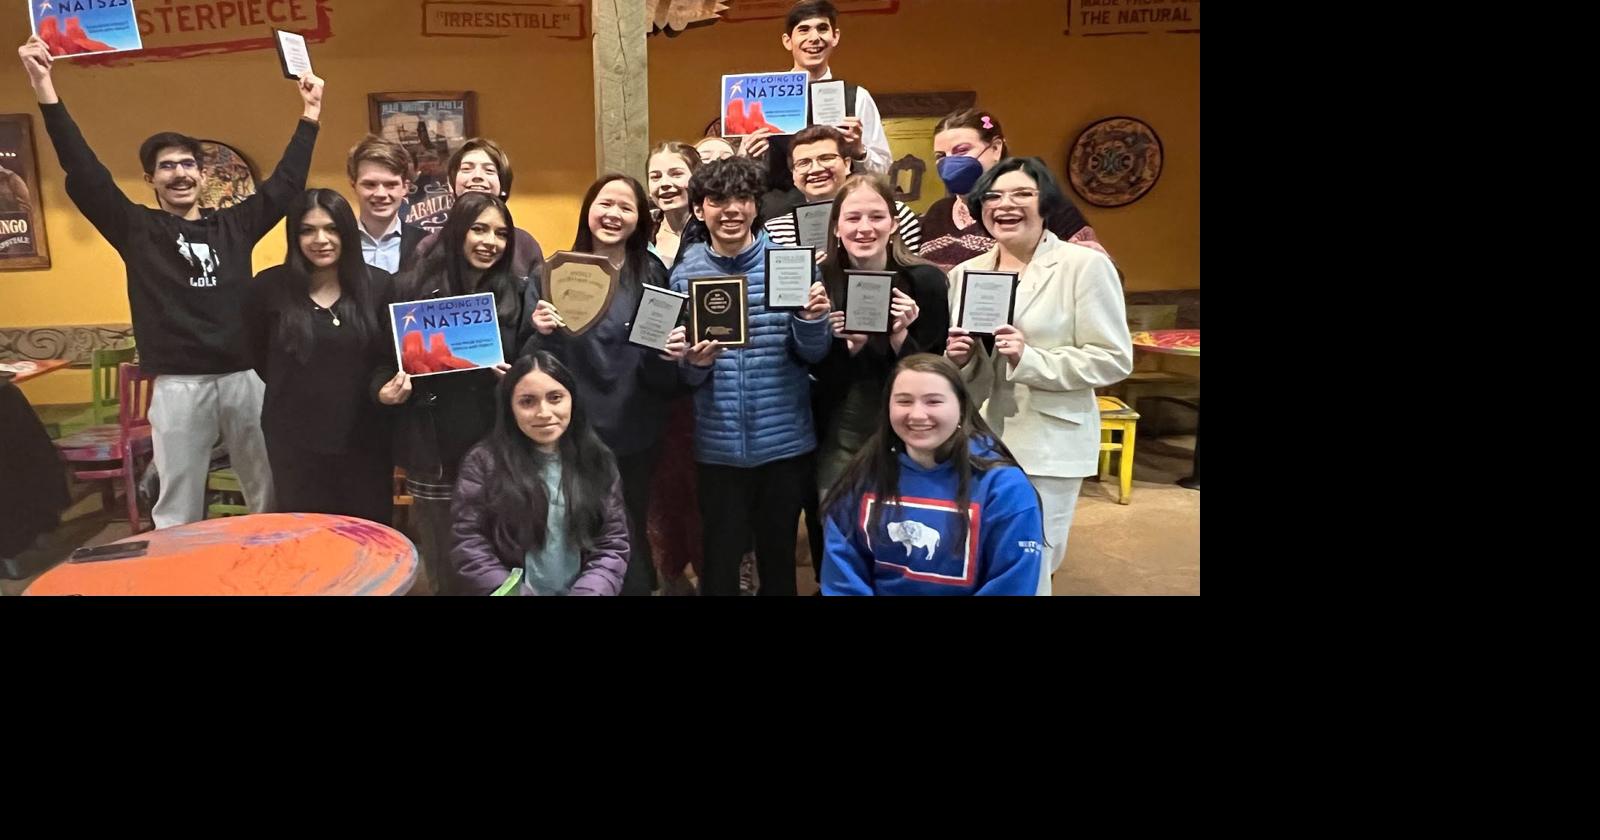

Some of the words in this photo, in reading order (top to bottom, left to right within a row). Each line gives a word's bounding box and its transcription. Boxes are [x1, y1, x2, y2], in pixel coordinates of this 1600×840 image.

[1081, 10, 1110, 25] THE
[1118, 8, 1193, 24] NATURAL
[760, 75, 789, 84] GOING
[791, 74, 804, 83] TO
[746, 84, 804, 99] NATS23
[439, 299, 472, 311] GOING
[475, 298, 490, 307] TO
[423, 309, 493, 330] NATS23
